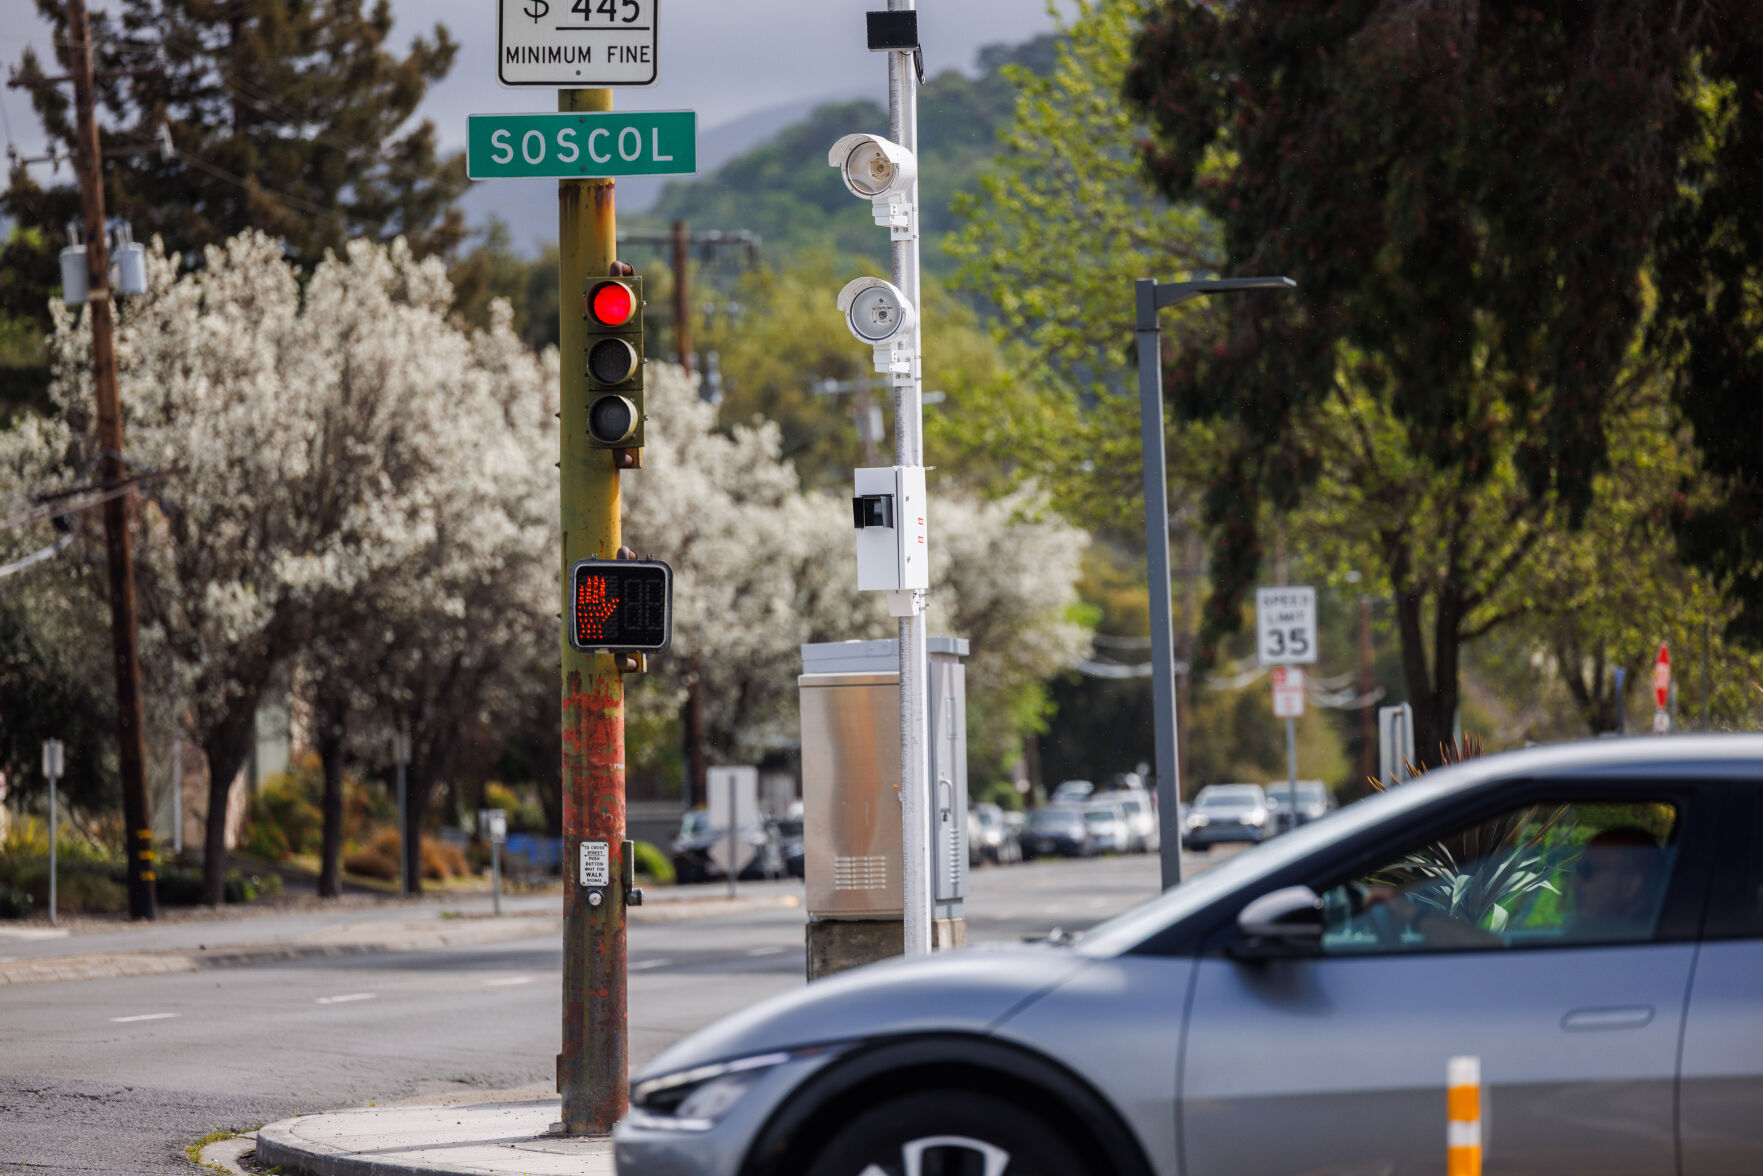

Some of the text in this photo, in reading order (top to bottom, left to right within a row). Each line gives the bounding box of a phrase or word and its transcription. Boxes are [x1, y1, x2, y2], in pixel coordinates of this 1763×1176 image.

[571, 0, 640, 23] 445
[506, 46, 651, 64] MINIMUM FINE
[490, 126, 674, 165] SOSCOL
[1266, 628, 1309, 657] 35
